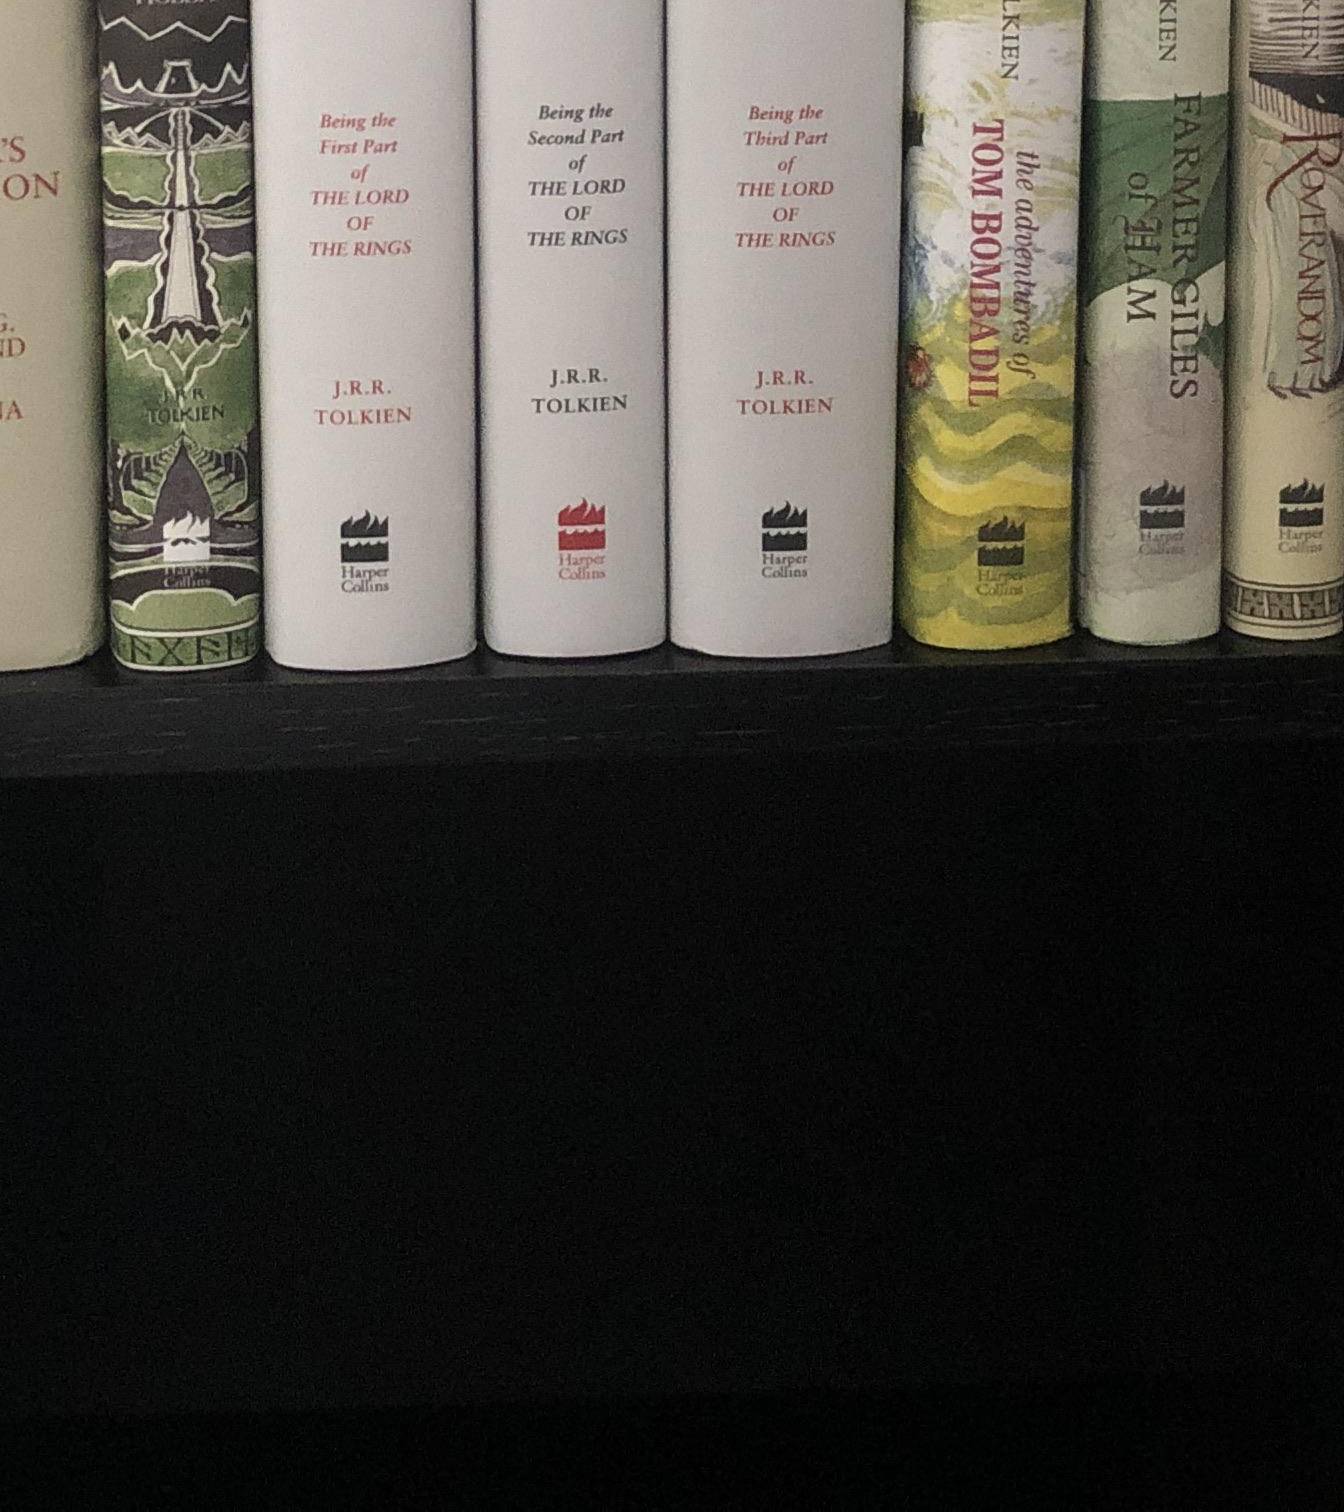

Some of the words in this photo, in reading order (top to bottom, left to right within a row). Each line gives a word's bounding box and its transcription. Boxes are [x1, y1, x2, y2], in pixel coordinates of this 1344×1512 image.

[319, 112, 367, 133] Being
[370, 112, 397, 130] the
[538, 104, 585, 125] Being
[588, 103, 614, 120] the
[748, 104, 796, 124] Being
[798, 103, 824, 121] the
[319, 138, 359, 156] First
[362, 137, 398, 155] Part
[527, 129, 588, 147] Second
[591, 128, 625, 146] Part
[743, 129, 791, 148] Third
[793, 129, 829, 147] Part
[971, 119, 1005, 201] TOM
[1015, 151, 1041, 190] the
[528, 180, 568, 197] THE
[571, 178, 626, 197] LORD
[736, 180, 776, 198] THE
[780, 178, 835, 197] LORD
[1128, 171, 1158, 207] of
[1171, 92, 1202, 269] FARMER
[310, 189, 350, 207] THE
[354, 188, 410, 206] LORD
[346, 214, 375, 233] OF
[564, 205, 592, 223] OF
[772, 205, 801, 223] OF
[527, 230, 567, 248] THE
[570, 228, 629, 247] RINGS
[735, 230, 775, 248] THE
[779, 229, 836, 248] RINGS
[309, 240, 348, 259] THE
[353, 239, 413, 258] RINGS
[1264, 131, 1343, 367] ROVERANDOM
[1012, 199, 1040, 345] adventures
[1114, 214, 1162, 324] HAM
[967, 210, 1004, 408] BOMBADIL
[1169, 278, 1200, 401] GILES
[1006, 352, 1036, 380] of
[550, 367, 609, 388] J.R.R.
[755, 369, 815, 390] J.R.R.
[332, 378, 392, 400] J.R.R.
[146, 404, 225, 425] TOLKIEN
[531, 394, 629, 415] TOLKIEN
[736, 396, 834, 417] TOLKIEN
[313, 406, 412, 426] TOLKIEN
[558, 553, 607, 569] Harper
[761, 552, 809, 568] Harper
[340, 565, 390, 582] Harper
[761, 565, 809, 580] Collins
[340, 578, 390, 595] Collins
